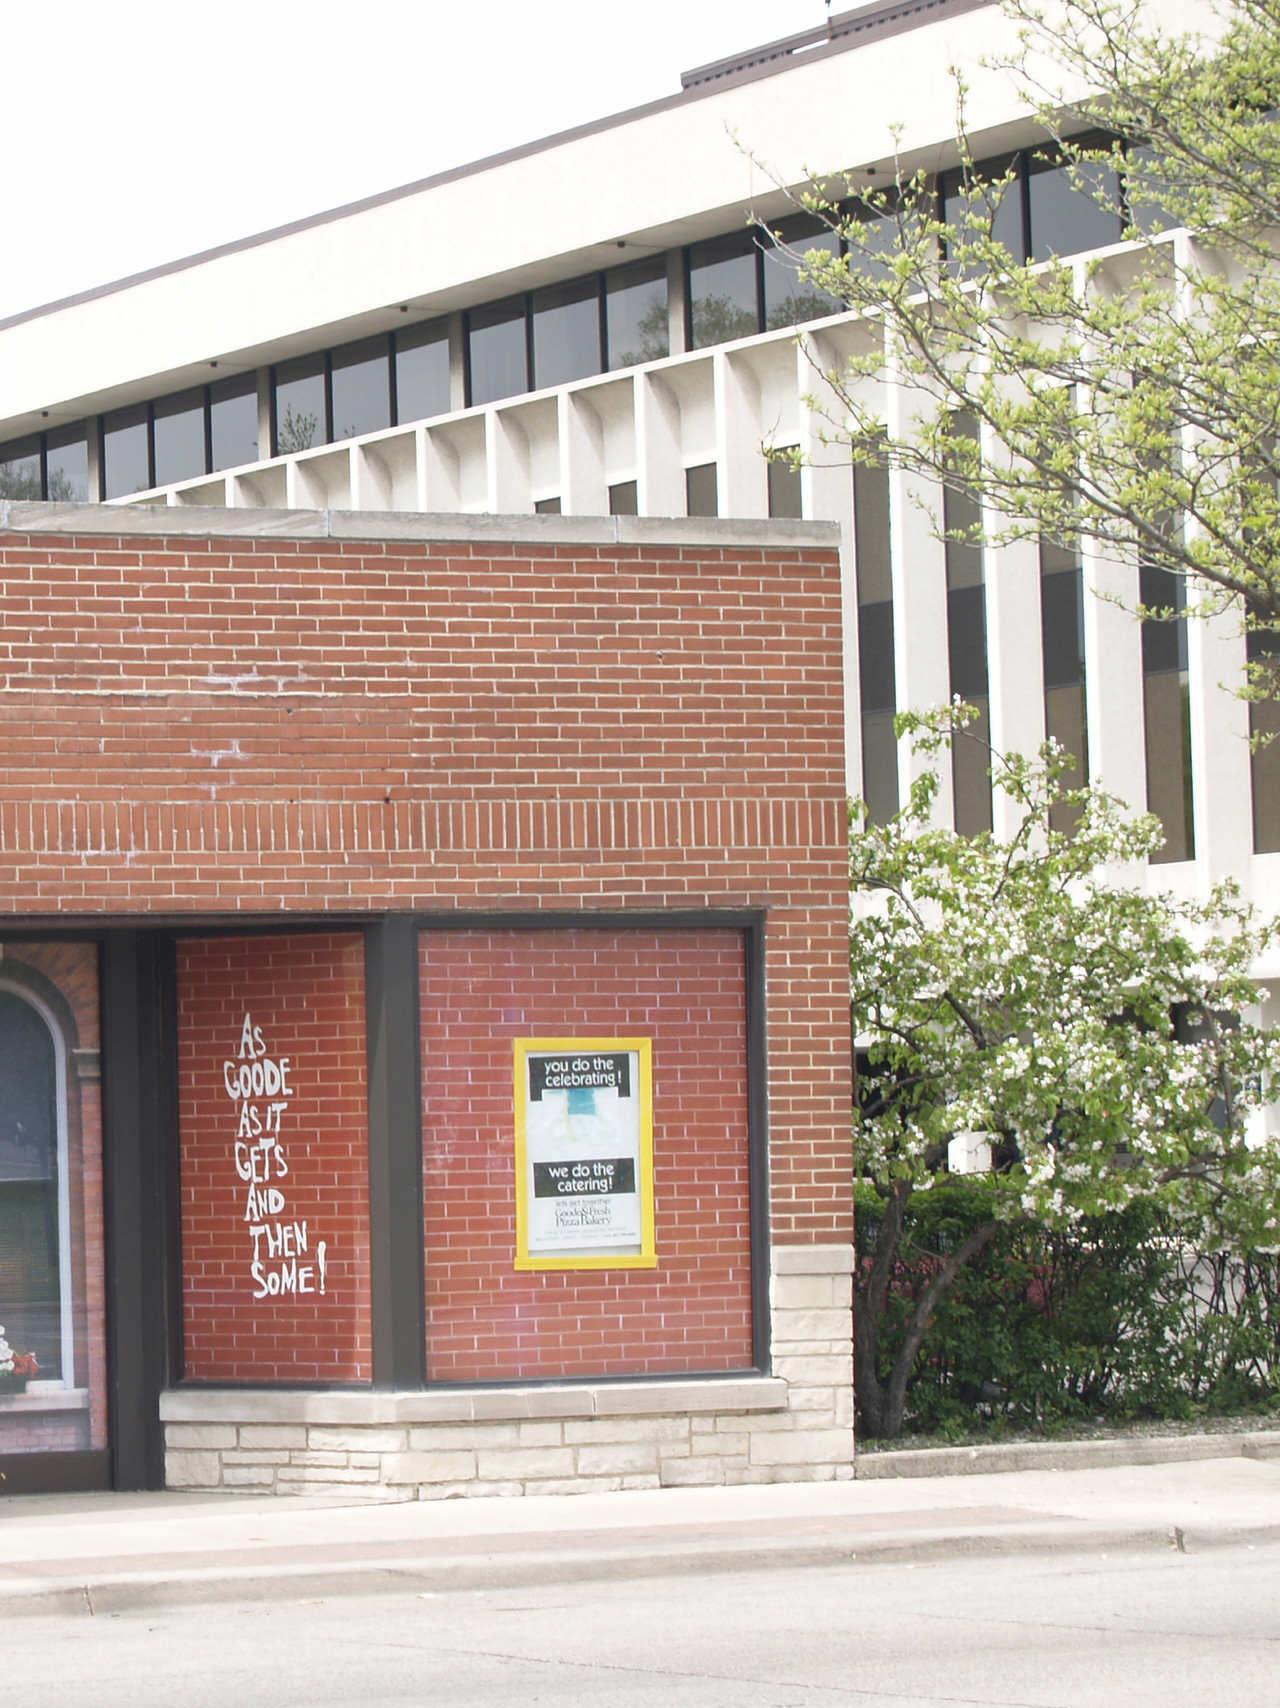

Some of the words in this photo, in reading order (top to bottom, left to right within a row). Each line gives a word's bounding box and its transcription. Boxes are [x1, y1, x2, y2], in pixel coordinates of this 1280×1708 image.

[223, 1058, 294, 1100] GOODE
[544, 1061, 569, 1074] you
[572, 1058, 590, 1072] do
[593, 1057, 615, 1070] the
[265, 1101, 288, 1133] IT
[234, 1137, 289, 1184] GETS
[548, 1166, 570, 1178] we
[572, 1163, 590, 1177] do
[593, 1162, 615, 1176] the
[557, 1176, 613, 1193] catering!
[243, 1183, 286, 1222] AND
[249, 1220, 308, 1262] THEN
